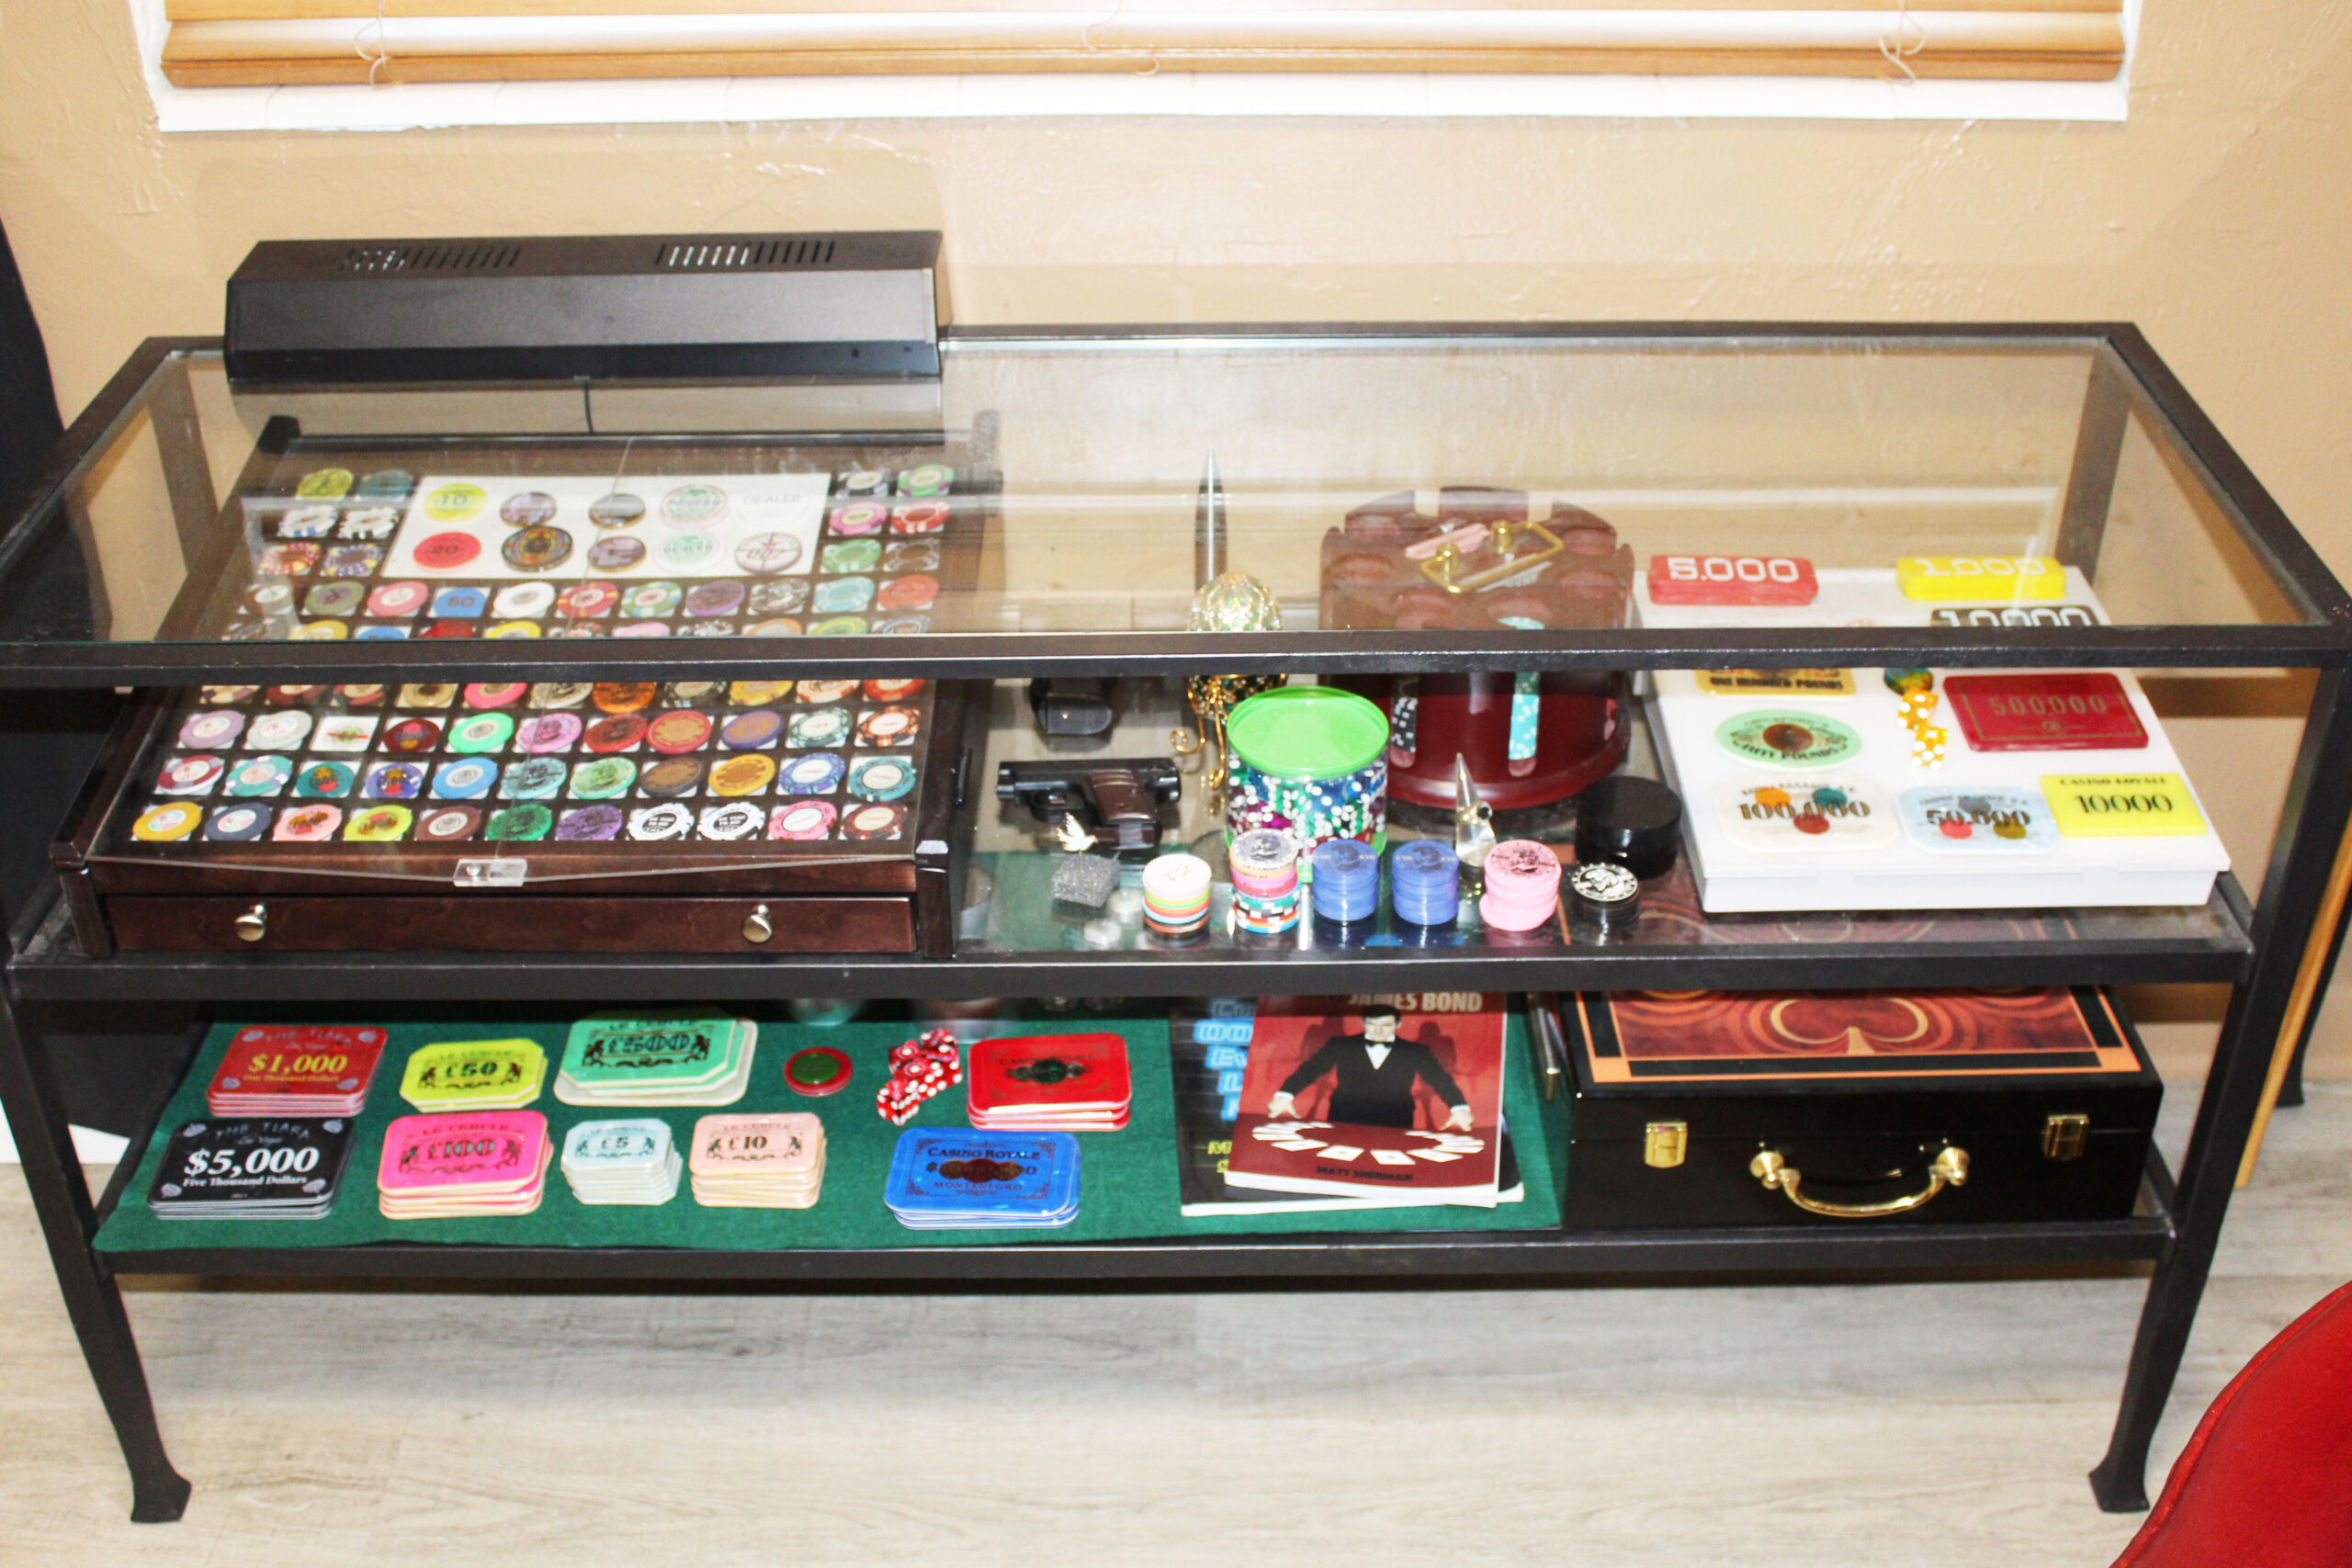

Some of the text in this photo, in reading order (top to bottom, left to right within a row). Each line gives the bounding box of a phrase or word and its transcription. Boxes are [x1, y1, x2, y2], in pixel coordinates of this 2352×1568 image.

[743, 492, 801, 504] DEALER
[1667, 557, 1800, 583] 5.000
[447, 595, 476, 608] 50
[1989, 694, 2108, 716] 500000
[2074, 794, 2174, 814] 10000
[1421, 992, 1483, 1011] BOND
[607, 1033, 691, 1055] £500
[248, 1053, 348, 1076] $1,000
[215, 1121, 311, 1140] THE TIARA
[427, 1138, 496, 1160] £100
[927, 1147, 1041, 1160] CASINO ROYALE
[184, 1146, 321, 1179] $5,000
[182, 1175, 308, 1188] Five Thousand Dollars
[933, 1181, 1023, 1191] MONTENEGRO
